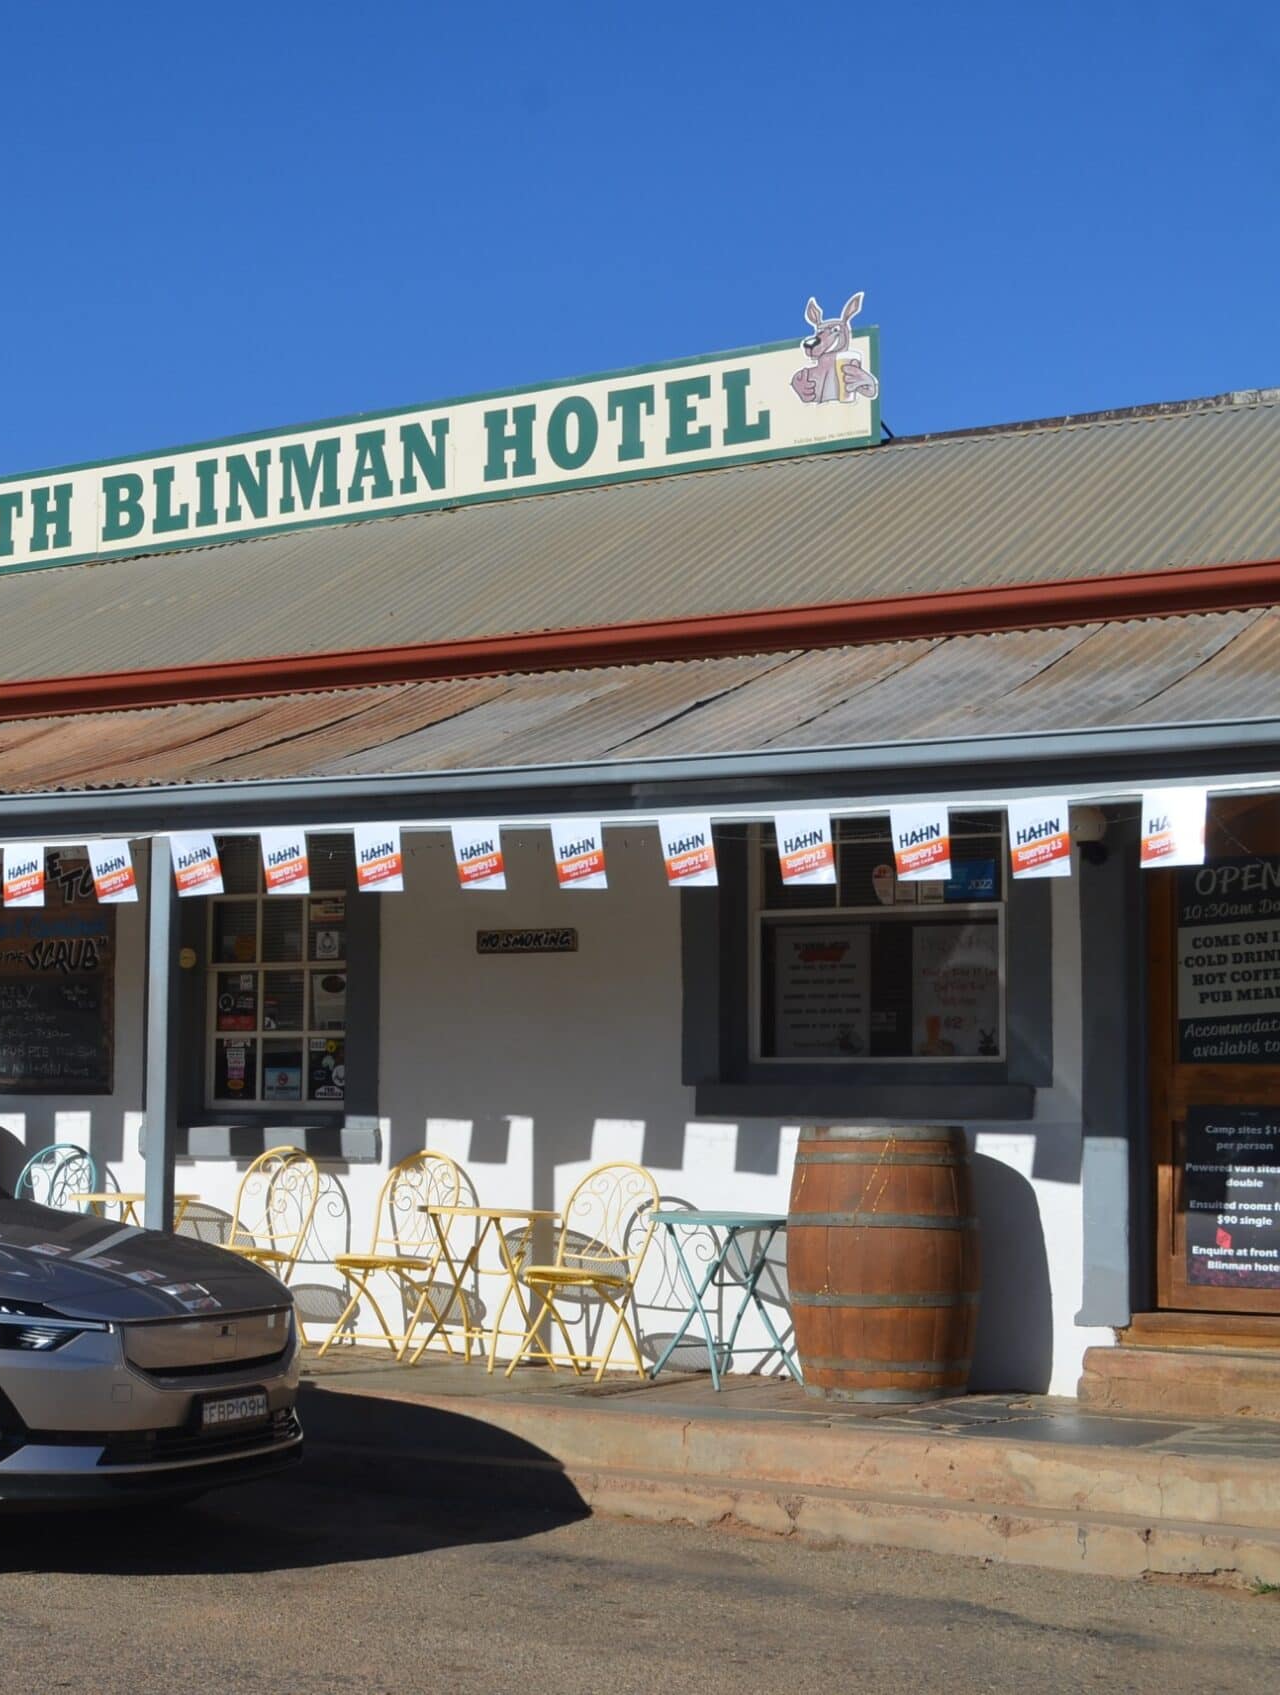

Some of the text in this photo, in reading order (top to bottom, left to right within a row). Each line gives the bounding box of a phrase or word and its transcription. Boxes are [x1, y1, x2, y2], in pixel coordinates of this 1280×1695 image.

[102, 418, 449, 542] BLINMAN
[483, 367, 771, 482] HOTEL
[899, 823, 941, 848] HAHN
[1016, 818, 1060, 845] HAHN
[460, 840, 494, 861] HAHN
[559, 836, 595, 859] HAHN
[668, 832, 705, 856] HAHN
[784, 829, 823, 854] HAHN
[178, 846, 212, 868] HAHN
[268, 844, 300, 866] HAHN
[360, 840, 394, 863] HAHN
[8, 860, 38, 879] HAHN
[95, 856, 126, 876] HAHN
[1195, 862, 1280, 896] OPEN
[480, 933, 500, 948] NO
[1192, 934, 1241, 950] COME
[1243, 931, 1269, 945] ON
[1184, 949, 1280, 969] COLD DRIN
[1192, 972, 1227, 987] HOT
[1198, 990, 1233, 1004] PUB
[1192, 1040, 1260, 1058] available
[1205, 1125, 1236, 1136] Camp
[1238, 1126, 1263, 1135] sites
[1216, 1142, 1274, 1152] per person
[1185, 1162, 1280, 1174] Powered van sites
[1226, 1178, 1264, 1188] double
[1190, 1200, 1237, 1210] Ensuited
[1238, 1202, 1272, 1212] rooms
[1217, 1214, 1272, 1228] $90 single
[1192, 1246, 1278, 1258] Enquire at front
[1208, 1260, 1252, 1271] Blinman
